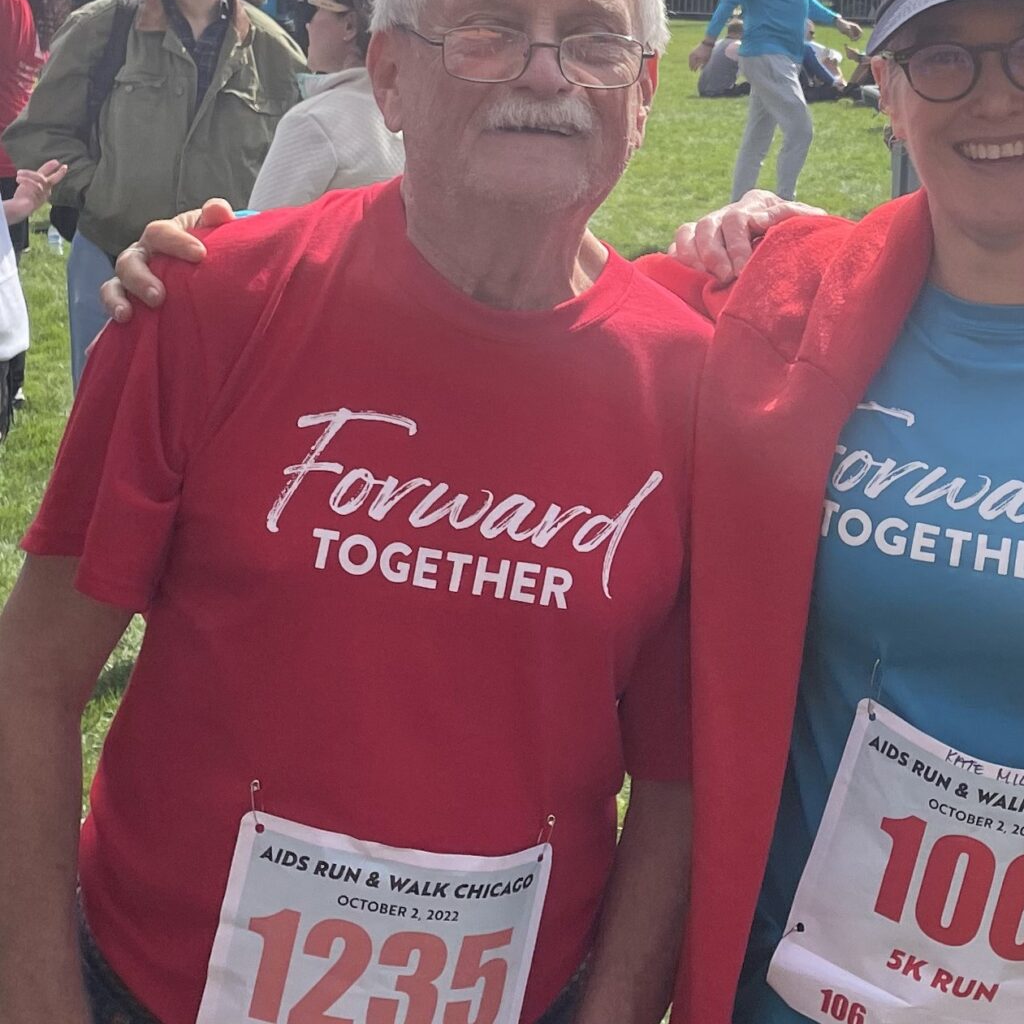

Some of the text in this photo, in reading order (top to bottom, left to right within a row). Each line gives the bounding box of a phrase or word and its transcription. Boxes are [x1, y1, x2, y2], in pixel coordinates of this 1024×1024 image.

[266, 407, 663, 600] Forward
[312, 527, 573, 610] TOGETHER
[868, 736, 910, 767] AIDS
[911, 758, 953, 791] RUN
[955, 782, 970, 799] &
[944, 748, 985, 775] KATE
[928, 798, 993, 830] OCTOBER
[996, 819, 1008, 835] 2,
[259, 845, 535, 901] AIDS RUN & WALK CHICAGO
[336, 894, 460, 923] OCTOBER 2, 2022
[247, 907, 514, 1024] 1235
[886, 948, 1000, 1003] 5K RUN
[819, 988, 867, 1024] 106
